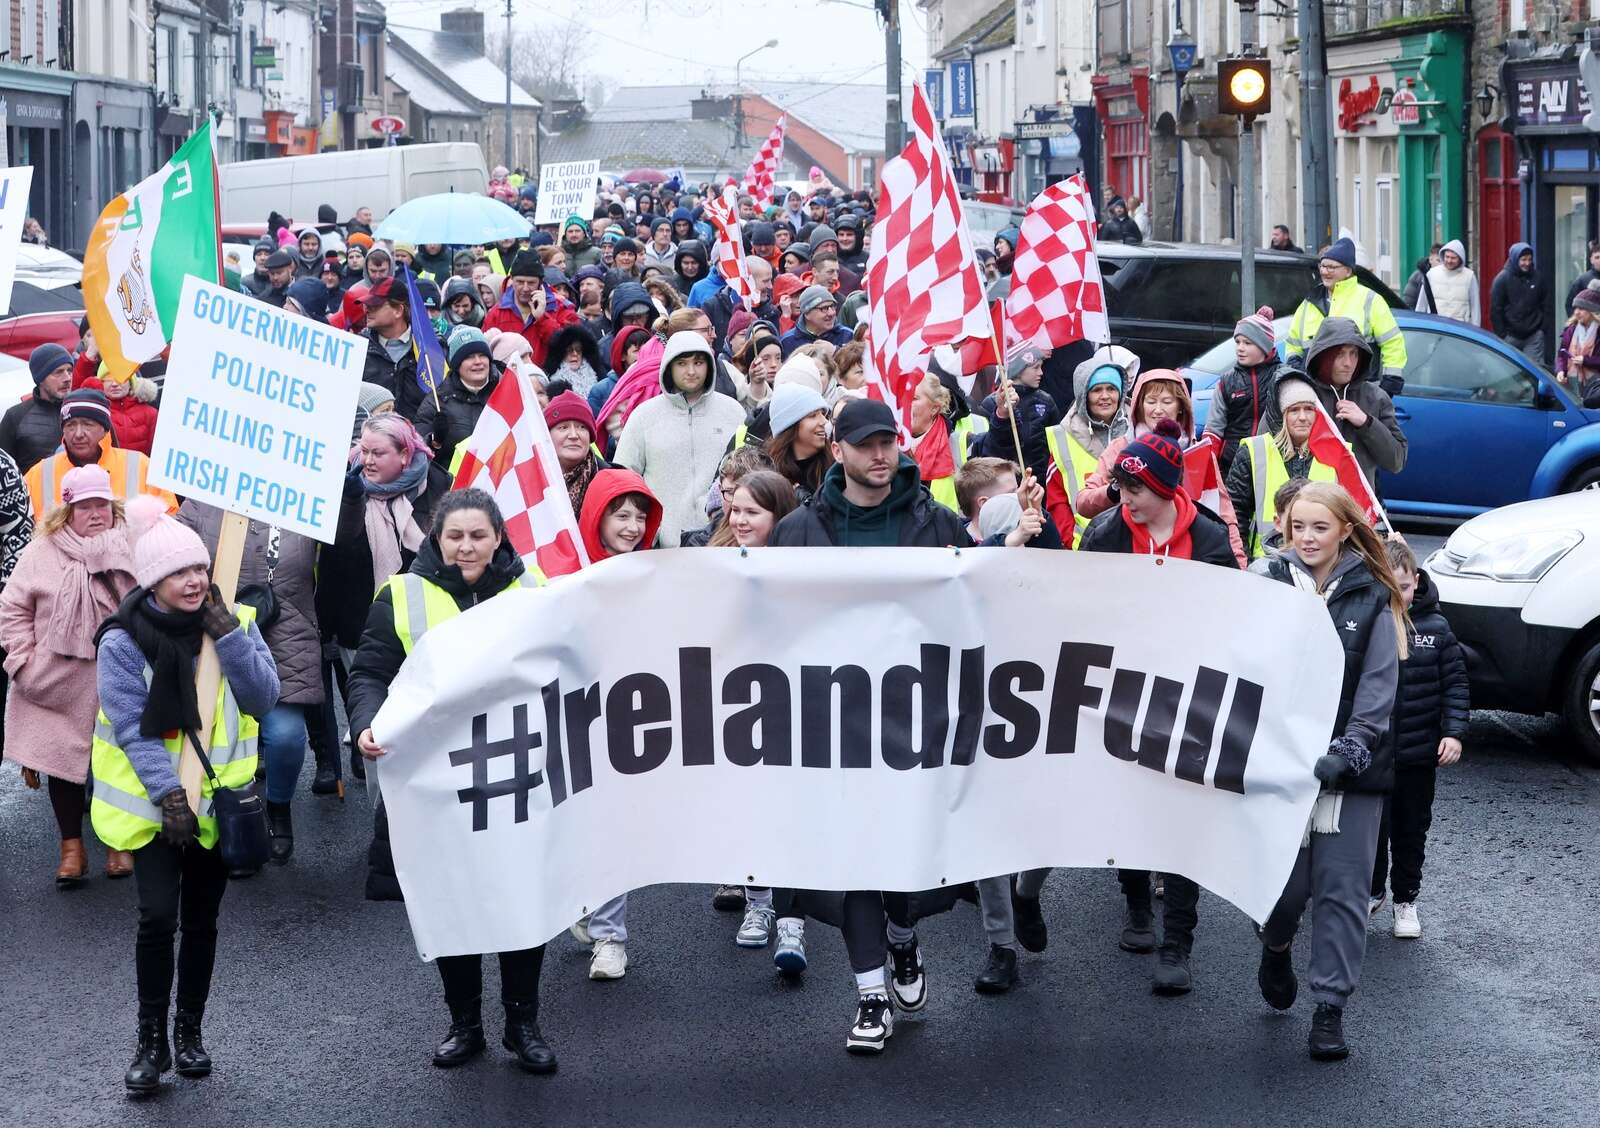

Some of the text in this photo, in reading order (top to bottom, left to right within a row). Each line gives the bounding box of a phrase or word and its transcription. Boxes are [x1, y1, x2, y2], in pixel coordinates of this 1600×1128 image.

[545, 162, 595, 178] IT COULD
[545, 177, 591, 192] BE YOUR
[551, 191, 583, 205] TOWN
[193, 288, 355, 371] GOVERNMENT
[211, 351, 317, 413] POLICIES
[182, 397, 326, 472] FAILING THE
[164, 448, 326, 528] IRISH PEOPLE
[1414, 635, 1435, 645] EA7
[448, 641, 1265, 832] #IrelandIsFull
